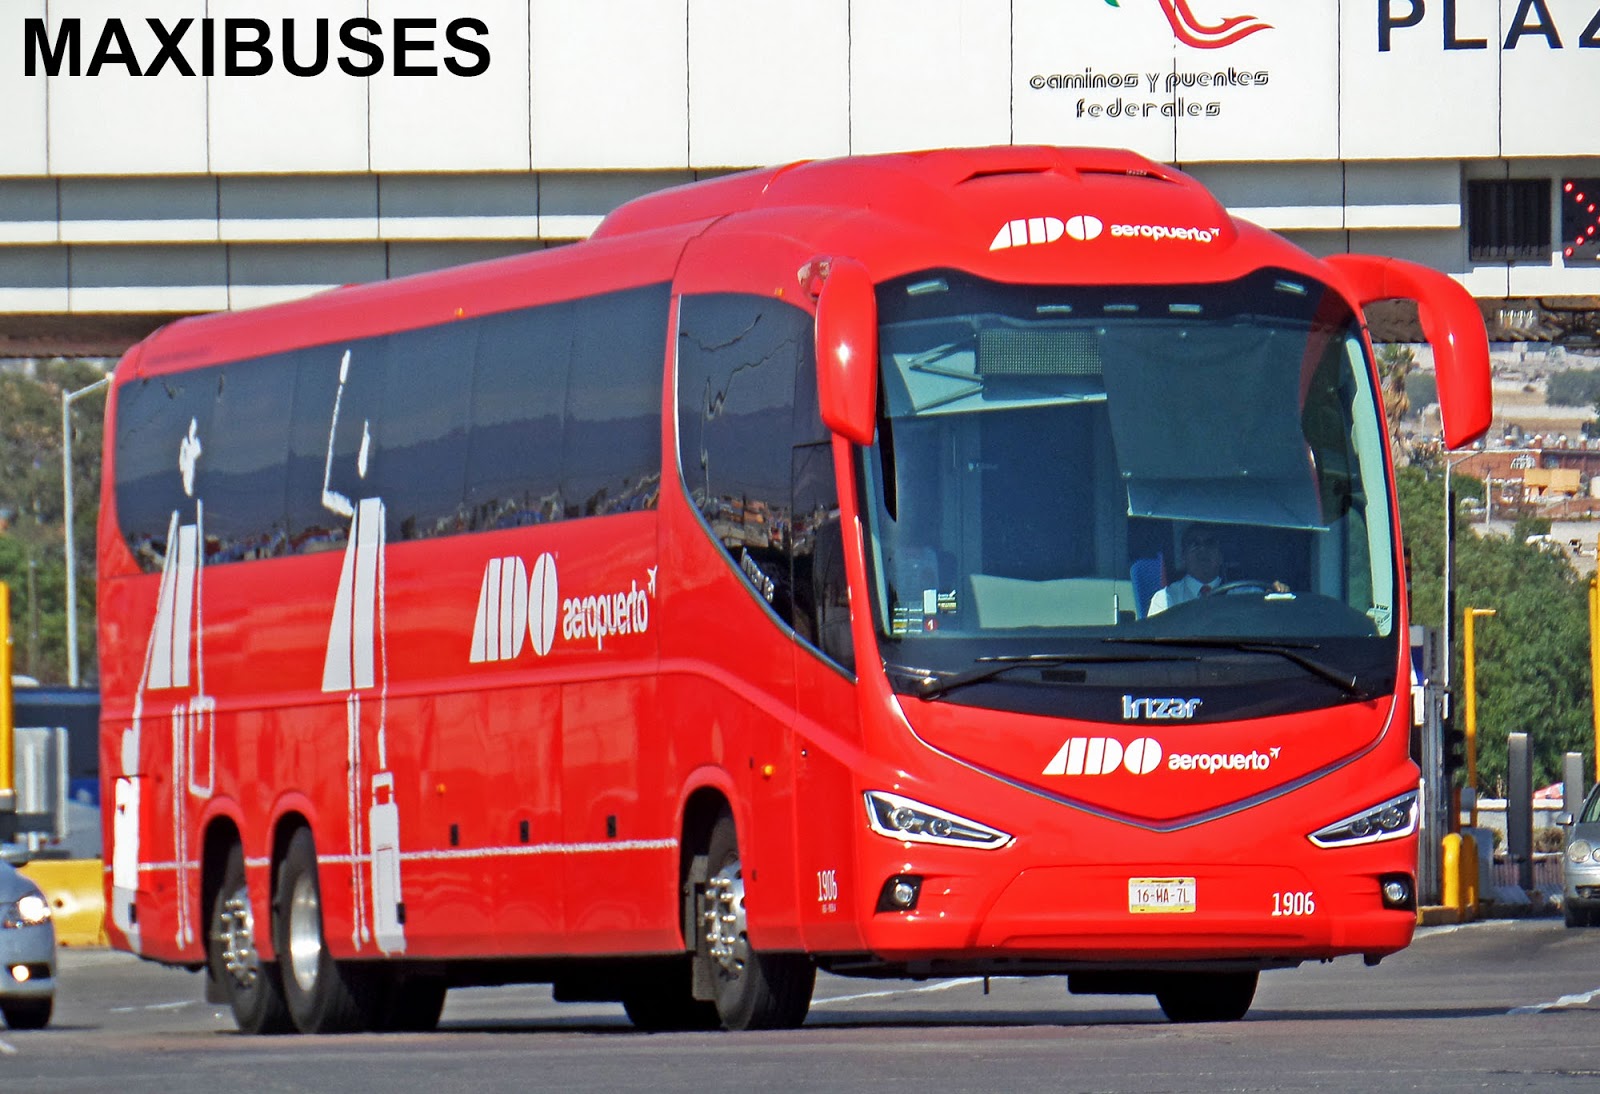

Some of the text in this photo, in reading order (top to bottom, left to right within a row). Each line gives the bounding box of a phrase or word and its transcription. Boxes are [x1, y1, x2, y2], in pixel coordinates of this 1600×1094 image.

[1029, 67, 1139, 89] caminos
[1165, 67, 1269, 93] puentes
[1076, 97, 1221, 118] federales
[989, 215, 1213, 251] ADO aeropuerto
[469, 552, 649, 663] ADO aeropuerto
[1041, 737, 1271, 775] ADO aeropuerto
[817, 870, 838, 901] 1906
[1137, 887, 1190, 904] 16-HA-7L
[1271, 891, 1315, 916] 1906
